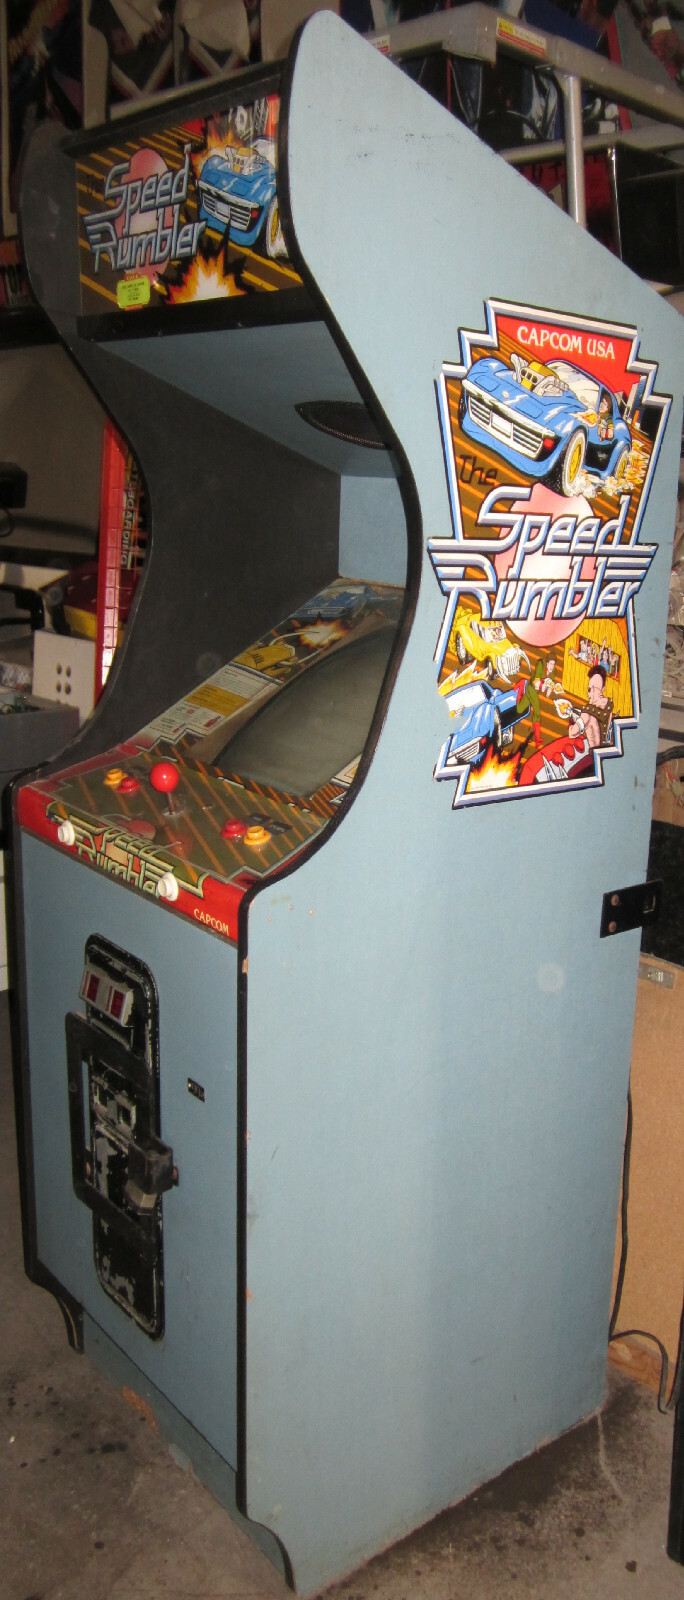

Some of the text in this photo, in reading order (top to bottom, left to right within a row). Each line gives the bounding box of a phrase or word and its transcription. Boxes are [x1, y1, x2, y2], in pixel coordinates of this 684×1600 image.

[83, 143, 192, 237] Speed
[85, 203, 207, 274] Rumbler
[517, 325, 616, 360] CAPCOM USA
[459, 454, 498, 486] The
[427, 493, 659, 580] Speed
[429, 551, 656, 620] Rumbler
[193, 908, 230, 937] CAPCOM
